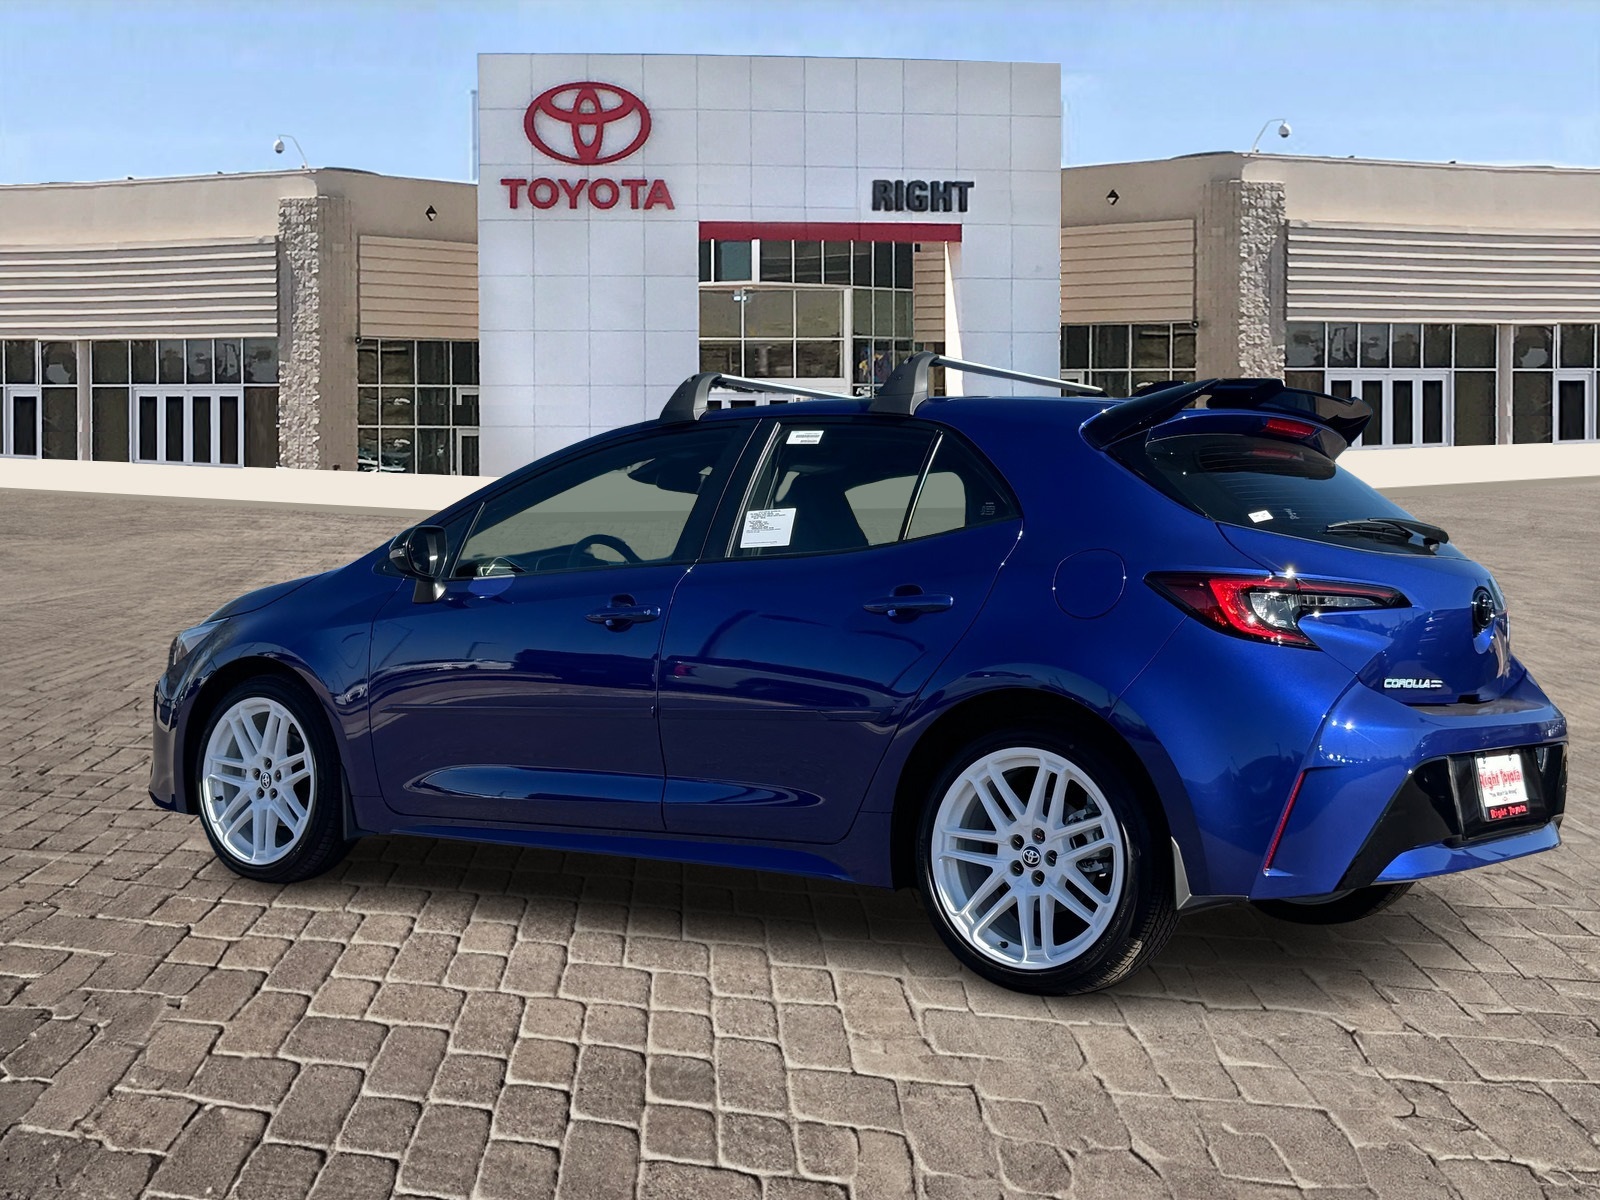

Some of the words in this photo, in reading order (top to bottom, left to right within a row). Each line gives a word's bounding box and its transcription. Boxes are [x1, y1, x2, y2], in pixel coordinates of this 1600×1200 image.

[500, 178, 675, 210] TOYOTA
[872, 179, 975, 212] RIGHT
[1383, 678, 1430, 688] COROLLA
[1479, 771, 1500, 790] Right
[1500, 769, 1522, 787] Toyota
[1490, 808, 1507, 819] Right
[1508, 805, 1527, 815] Toyota
